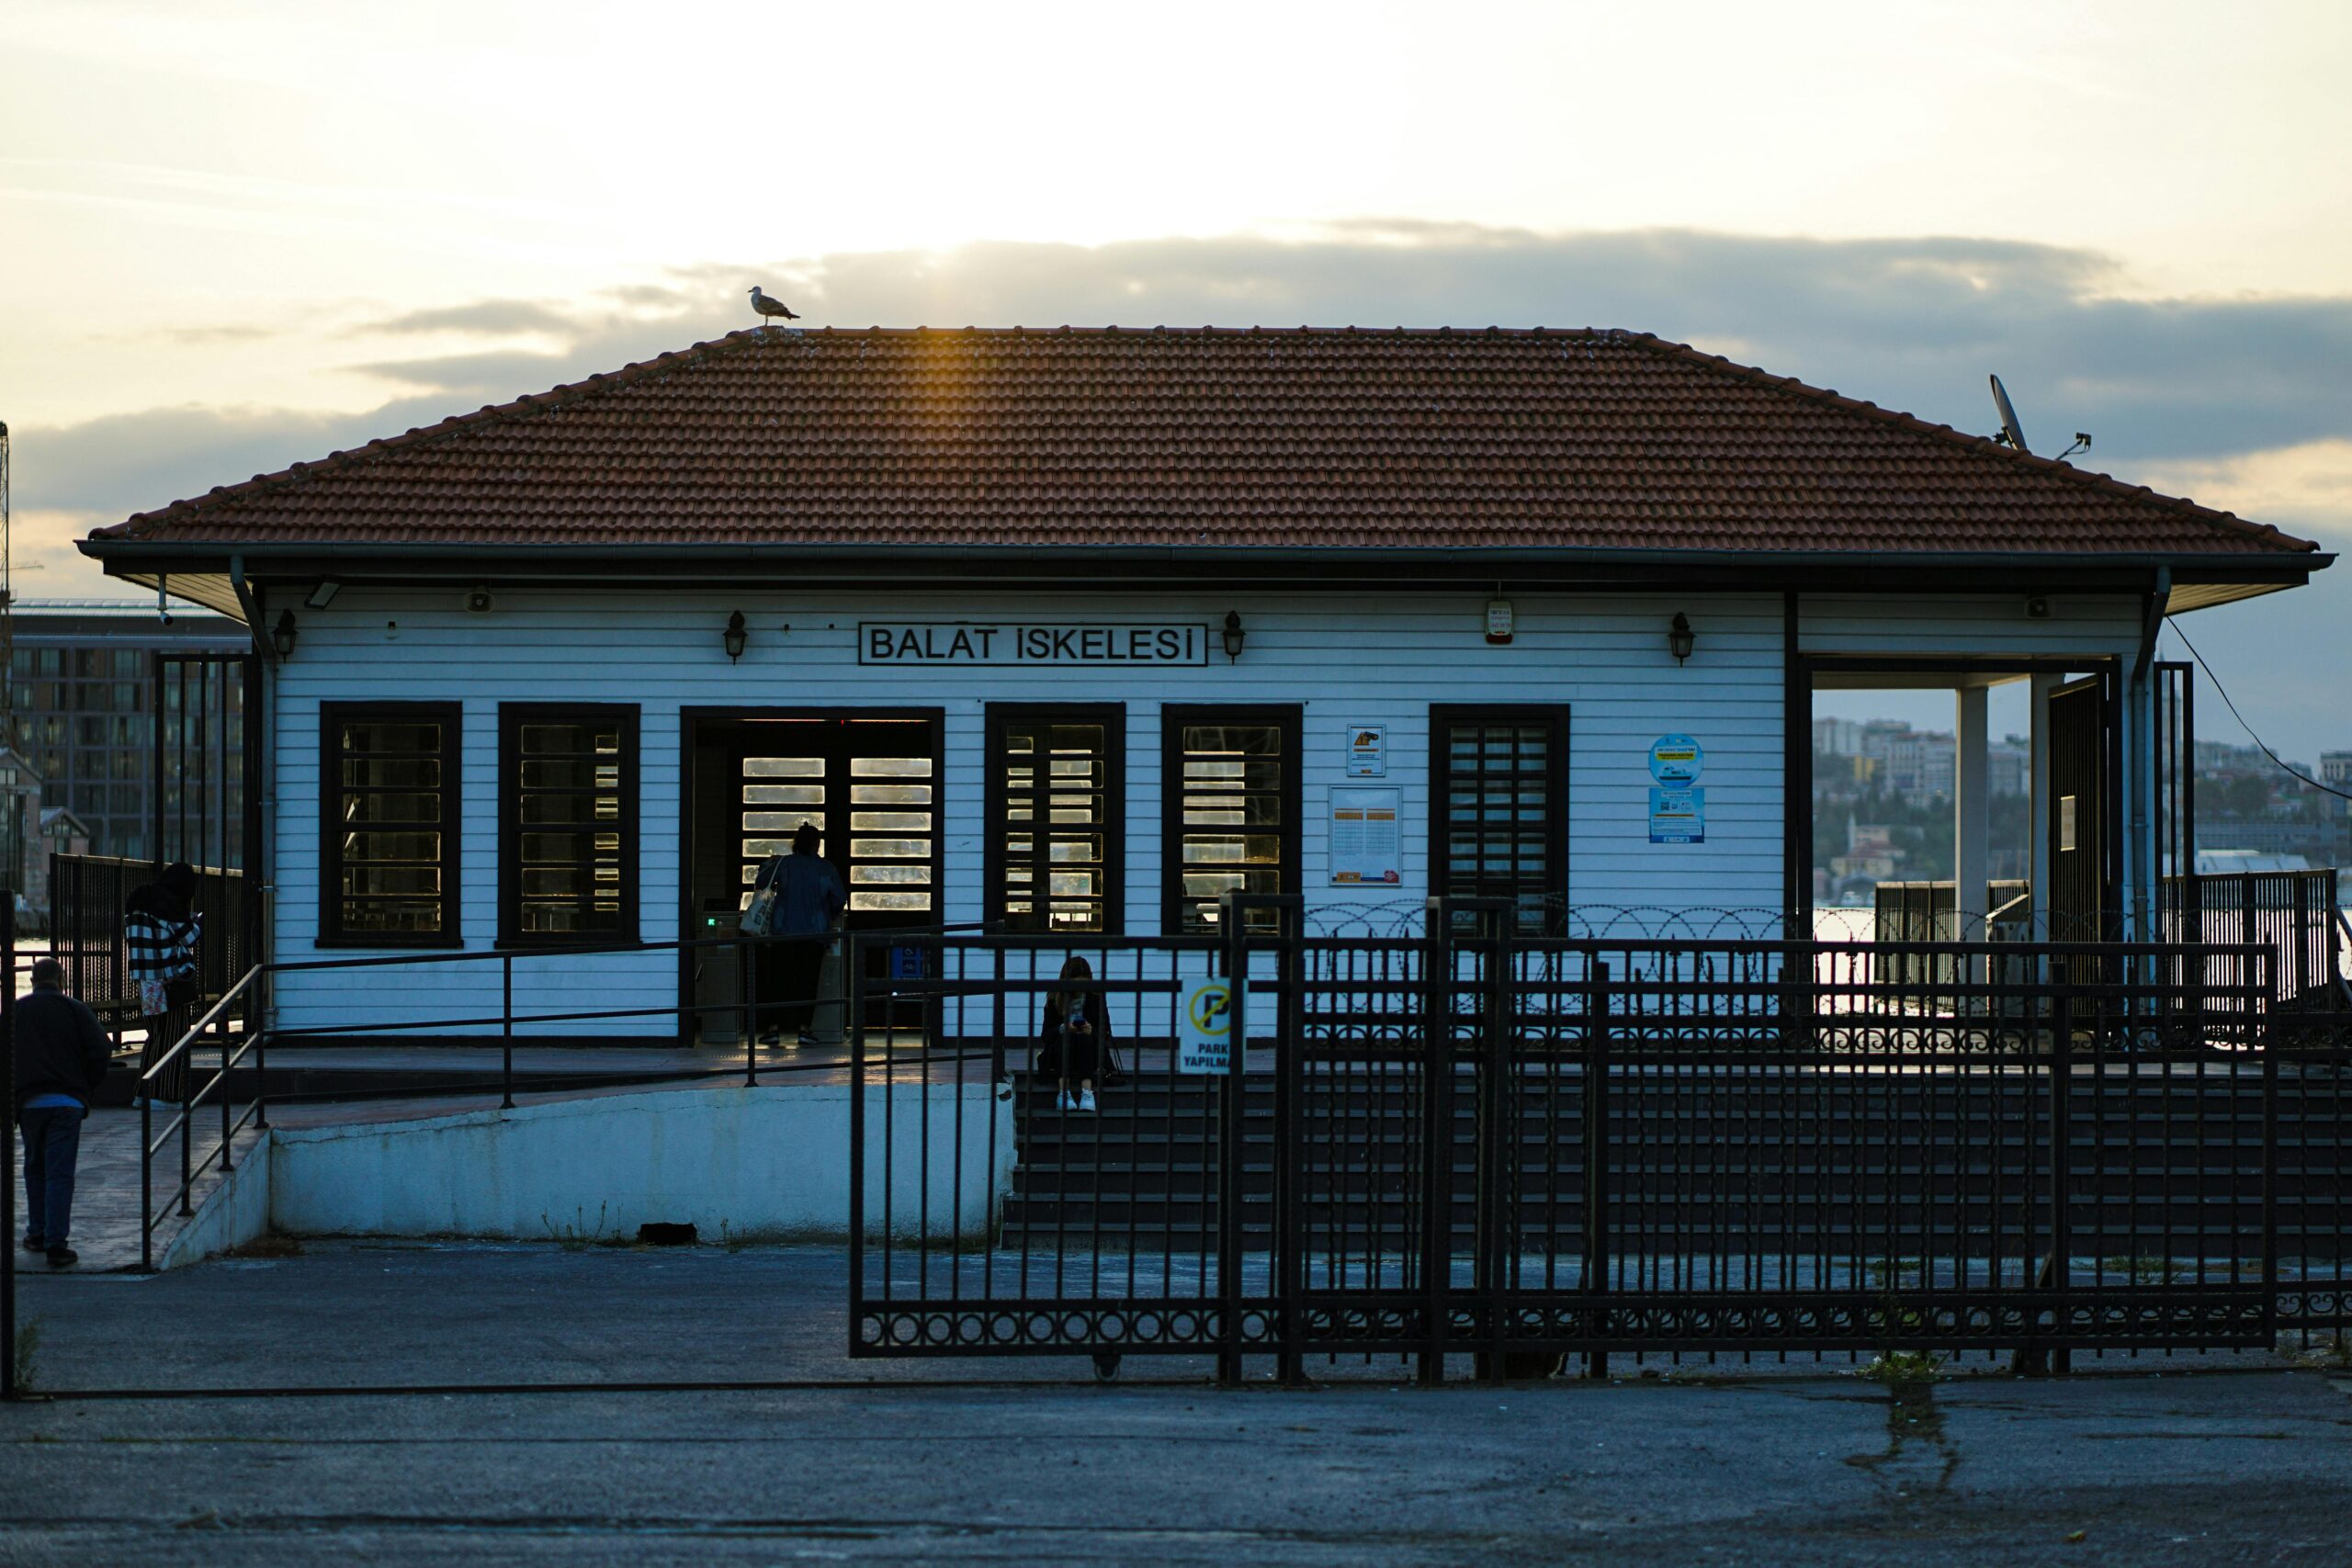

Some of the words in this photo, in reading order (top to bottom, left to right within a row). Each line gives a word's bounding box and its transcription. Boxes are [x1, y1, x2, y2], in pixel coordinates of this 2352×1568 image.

[870, 628, 999, 660] BALAT
[1017, 627, 1193, 660] İSKELESİ
[1198, 1043, 1228, 1055] PARK
[1184, 1056, 1230, 1067] YAPILM
